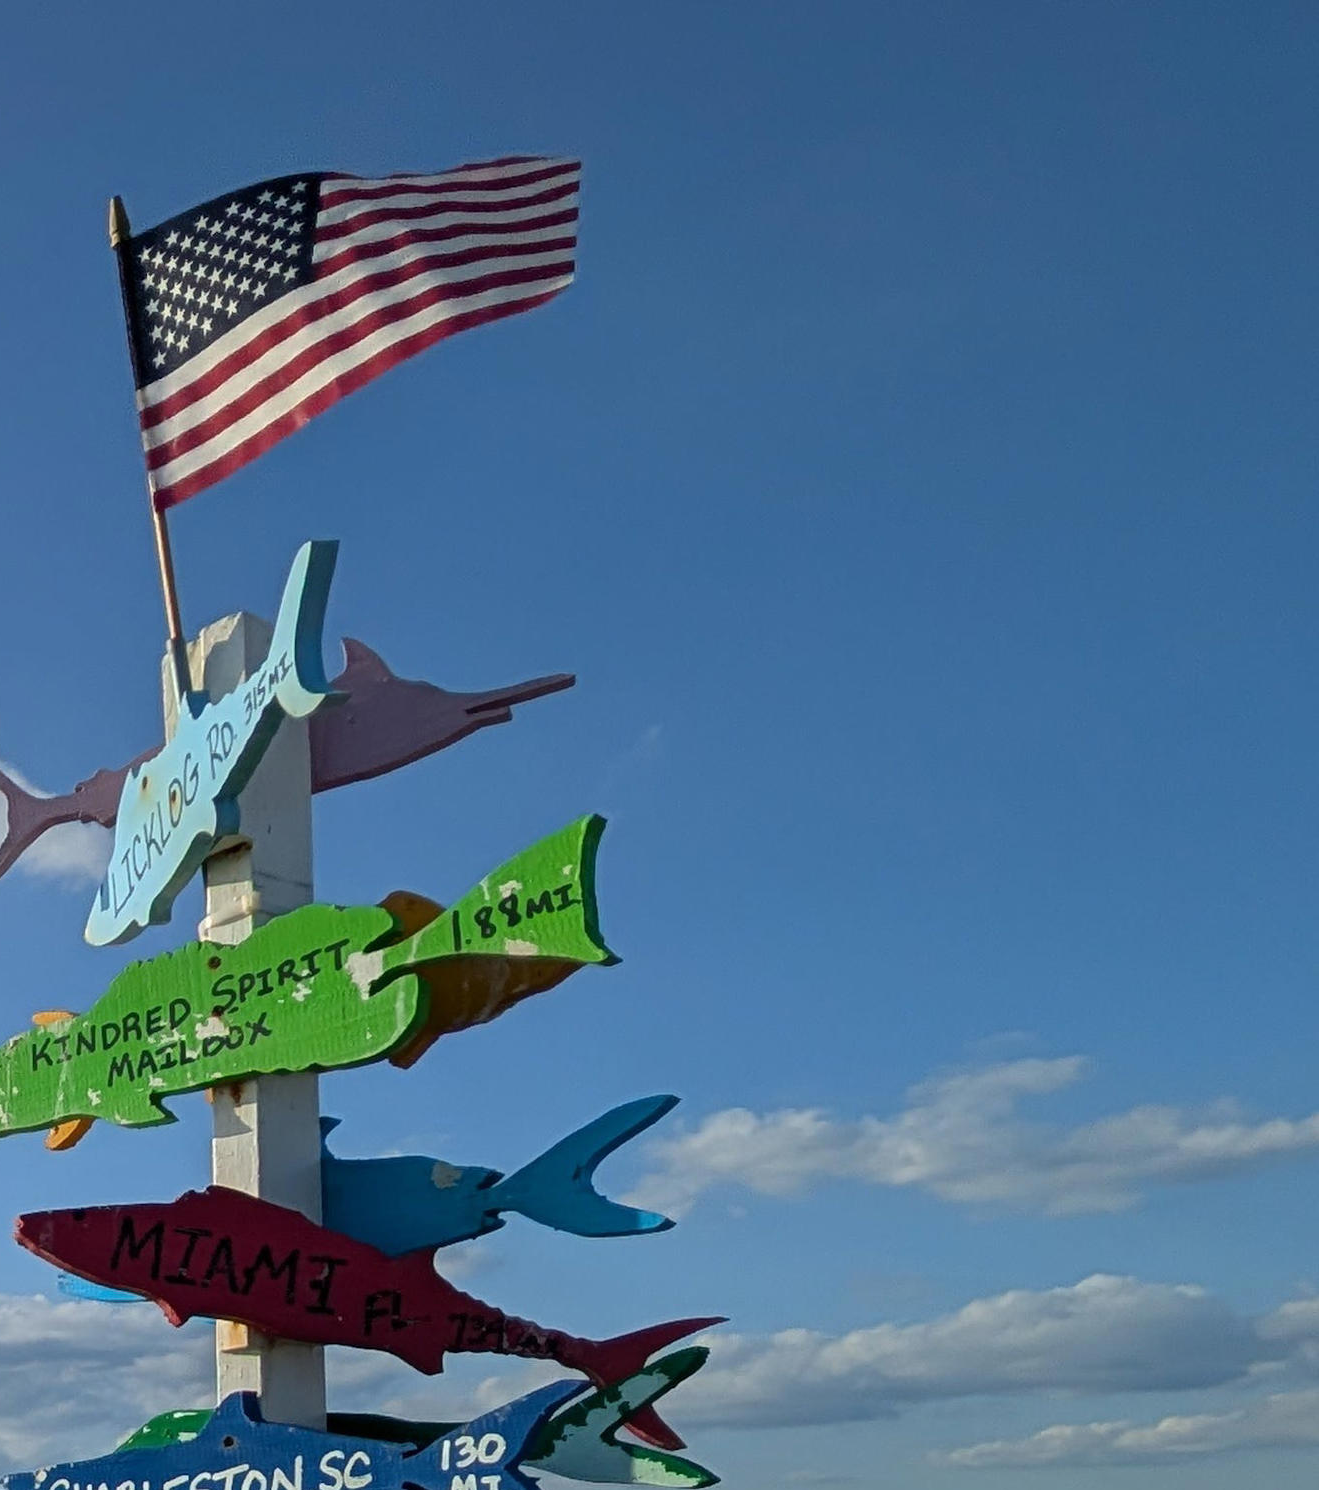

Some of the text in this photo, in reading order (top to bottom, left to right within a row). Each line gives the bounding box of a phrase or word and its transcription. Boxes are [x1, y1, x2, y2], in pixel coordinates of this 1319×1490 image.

[111, 752, 200, 919] LICKLOG
[32, 938, 350, 1072] KINDRED SPIRIT
[109, 1216, 348, 1315] MIAMI
[440, 1432, 507, 1472] 130
